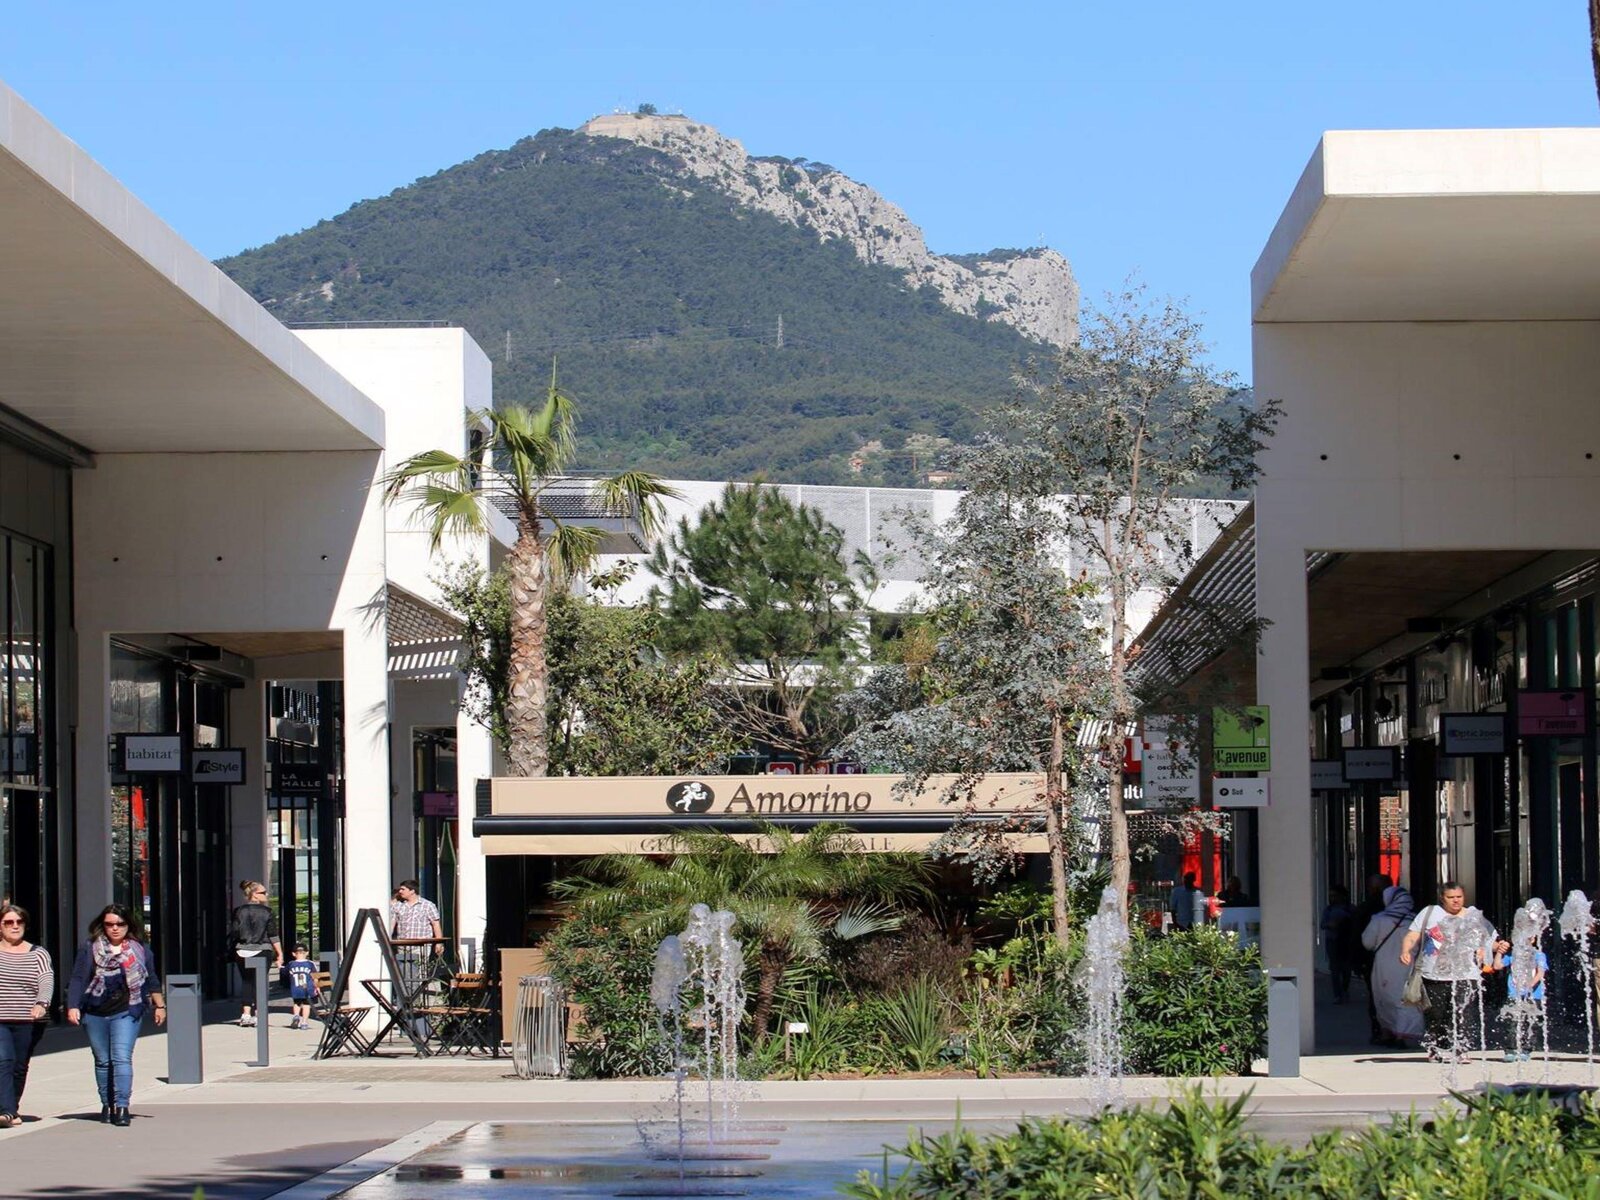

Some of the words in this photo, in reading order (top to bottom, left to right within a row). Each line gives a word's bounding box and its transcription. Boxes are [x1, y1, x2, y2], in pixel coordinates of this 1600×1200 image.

[127, 748, 172, 759] habitat
[1216, 749, 1267, 764] l'avenue
[724, 783, 872, 813] Amorino
